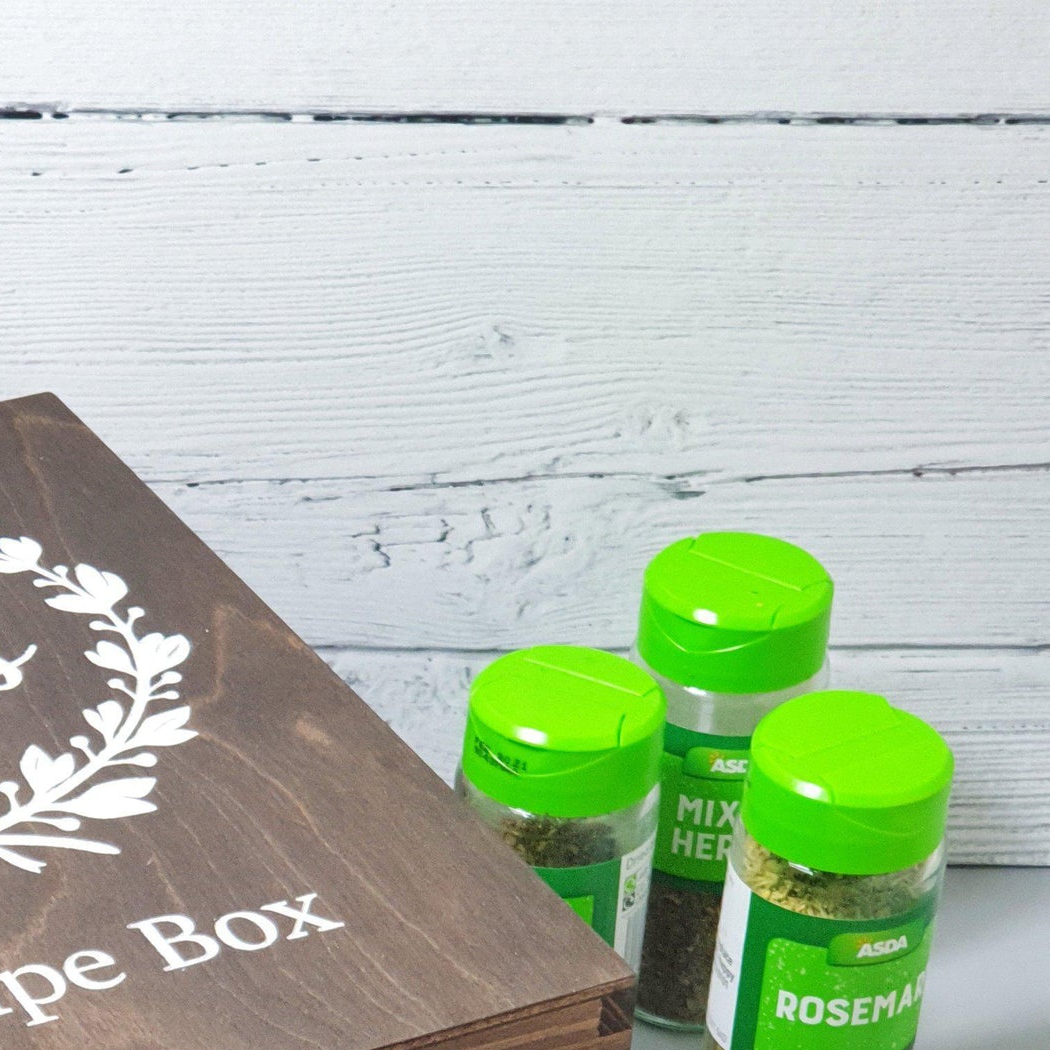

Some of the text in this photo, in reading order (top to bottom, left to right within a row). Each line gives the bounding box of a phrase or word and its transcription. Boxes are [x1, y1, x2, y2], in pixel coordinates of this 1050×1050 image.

[677, 794, 740, 828] MIX
[127, 892, 345, 972] Box
[856, 935, 907, 958] ASDA
